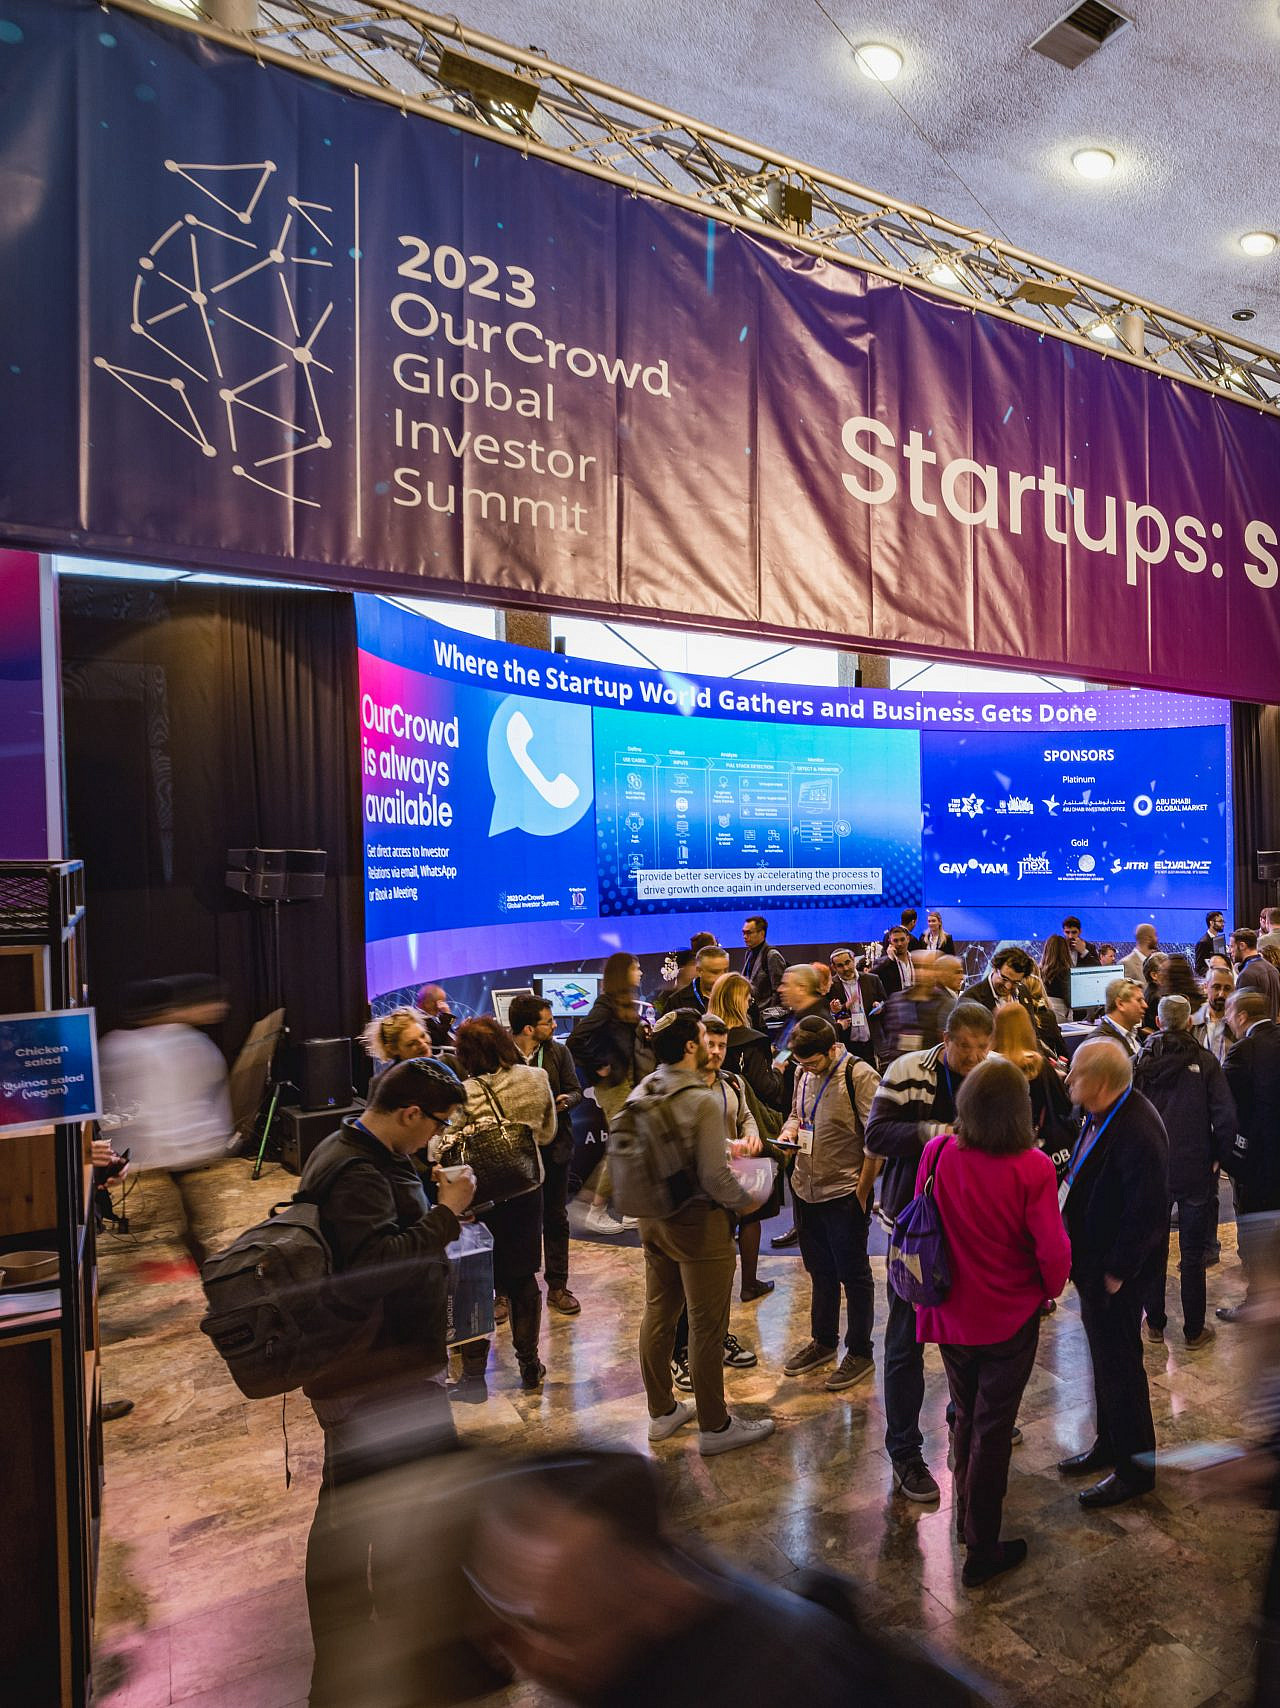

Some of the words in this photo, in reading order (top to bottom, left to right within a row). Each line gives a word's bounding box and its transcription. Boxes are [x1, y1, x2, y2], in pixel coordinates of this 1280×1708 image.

[398, 235, 536, 309] 2023
[390, 292, 672, 399] OurCrowd
[393, 353, 553, 422] Global
[395, 408, 597, 482] Investor
[393, 467, 588, 536] Summit
[841, 415, 1224, 586] Startups:
[433, 638, 498, 679] Where
[503, 656, 540, 687] the
[546, 667, 634, 705] Startup
[639, 680, 712, 709] World
[718, 690, 814, 718] Gathers
[820, 695, 864, 719] and
[873, 697, 975, 722] Business
[981, 703, 1032, 724] Gets
[1040, 704, 1097, 723] Done
[362, 694, 459, 748] OurCrowd
[1043, 749, 1114, 762] SPONSORS
[363, 738, 377, 776] is
[379, 743, 450, 796] always
[1062, 775, 1096, 785] Platinum
[365, 790, 453, 827] available
[1071, 838, 1089, 847] Gold
[367, 844, 376, 857] Get
[392, 847, 411, 857] access
[412, 846, 420, 857] to
[421, 845, 450, 857] Investor
[420, 865, 457, 879] WhatsApp
[639, 871, 672, 882] provide
[674, 870, 700, 880] better
[704, 870, 742, 880] services
[744, 870, 755, 881] by
[757, 870, 813, 881] accelerating
[815, 870, 830, 879] the
[832, 871, 868, 881] process
[869, 870, 880, 878] to
[939, 863, 968, 874] GAV
[979, 863, 1008, 874] YAM
[393, 885, 418, 901] Meeting
[643, 884, 666, 894] drive
[667, 883, 700, 895] growth
[701, 884, 724, 893] once
[726, 883, 752, 895] again
[754, 883, 763, 892] in
[765, 882, 821, 892] underserved
[823, 882, 876, 892] economies.
[16, 1045, 69, 1057] Chicken
[24, 1056, 61, 1067] salad
[51, 1074, 84, 1084] salad
[22, 1085, 68, 1100] (vegan)
